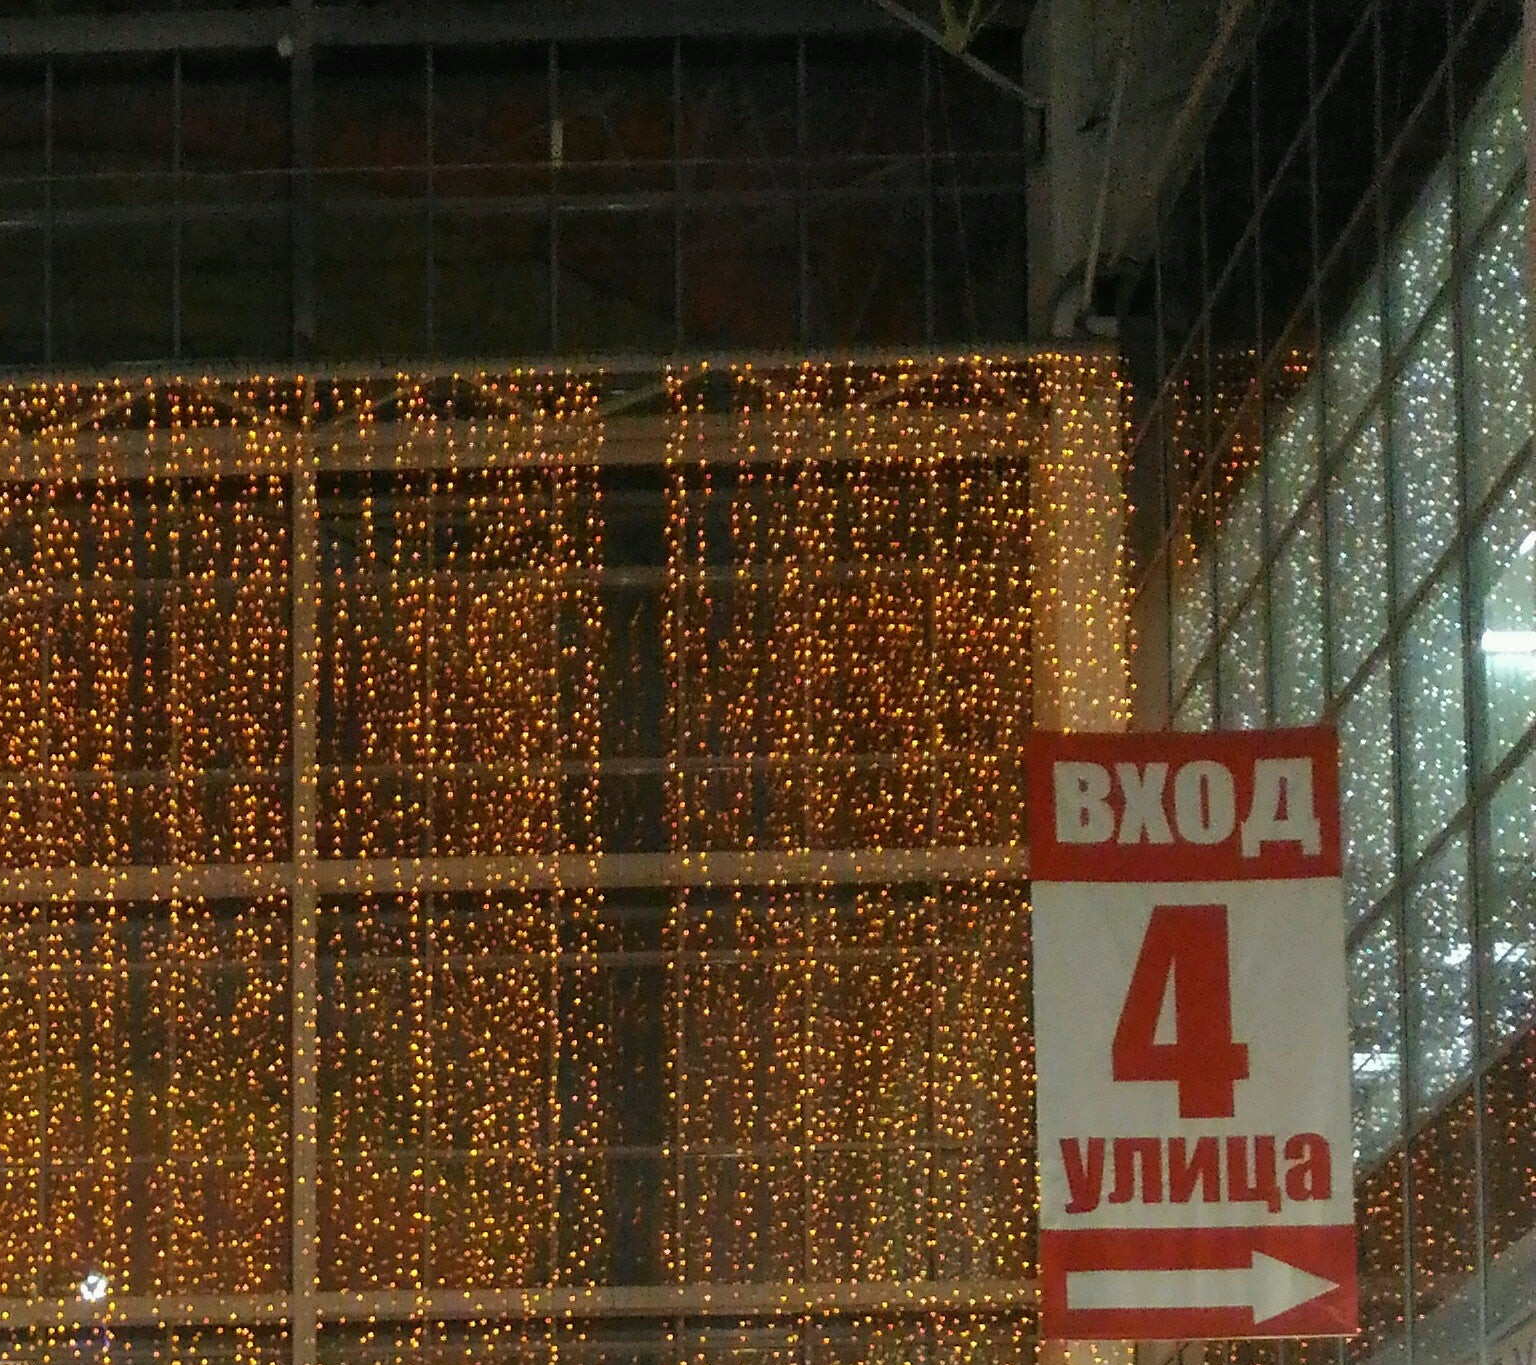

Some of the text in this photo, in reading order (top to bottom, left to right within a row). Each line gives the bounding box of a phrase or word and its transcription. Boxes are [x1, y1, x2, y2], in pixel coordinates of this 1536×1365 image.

[1053, 757, 1322, 858] ВХОД
[1111, 904, 1250, 1119] 4
[1059, 1131, 1332, 1214] улица
